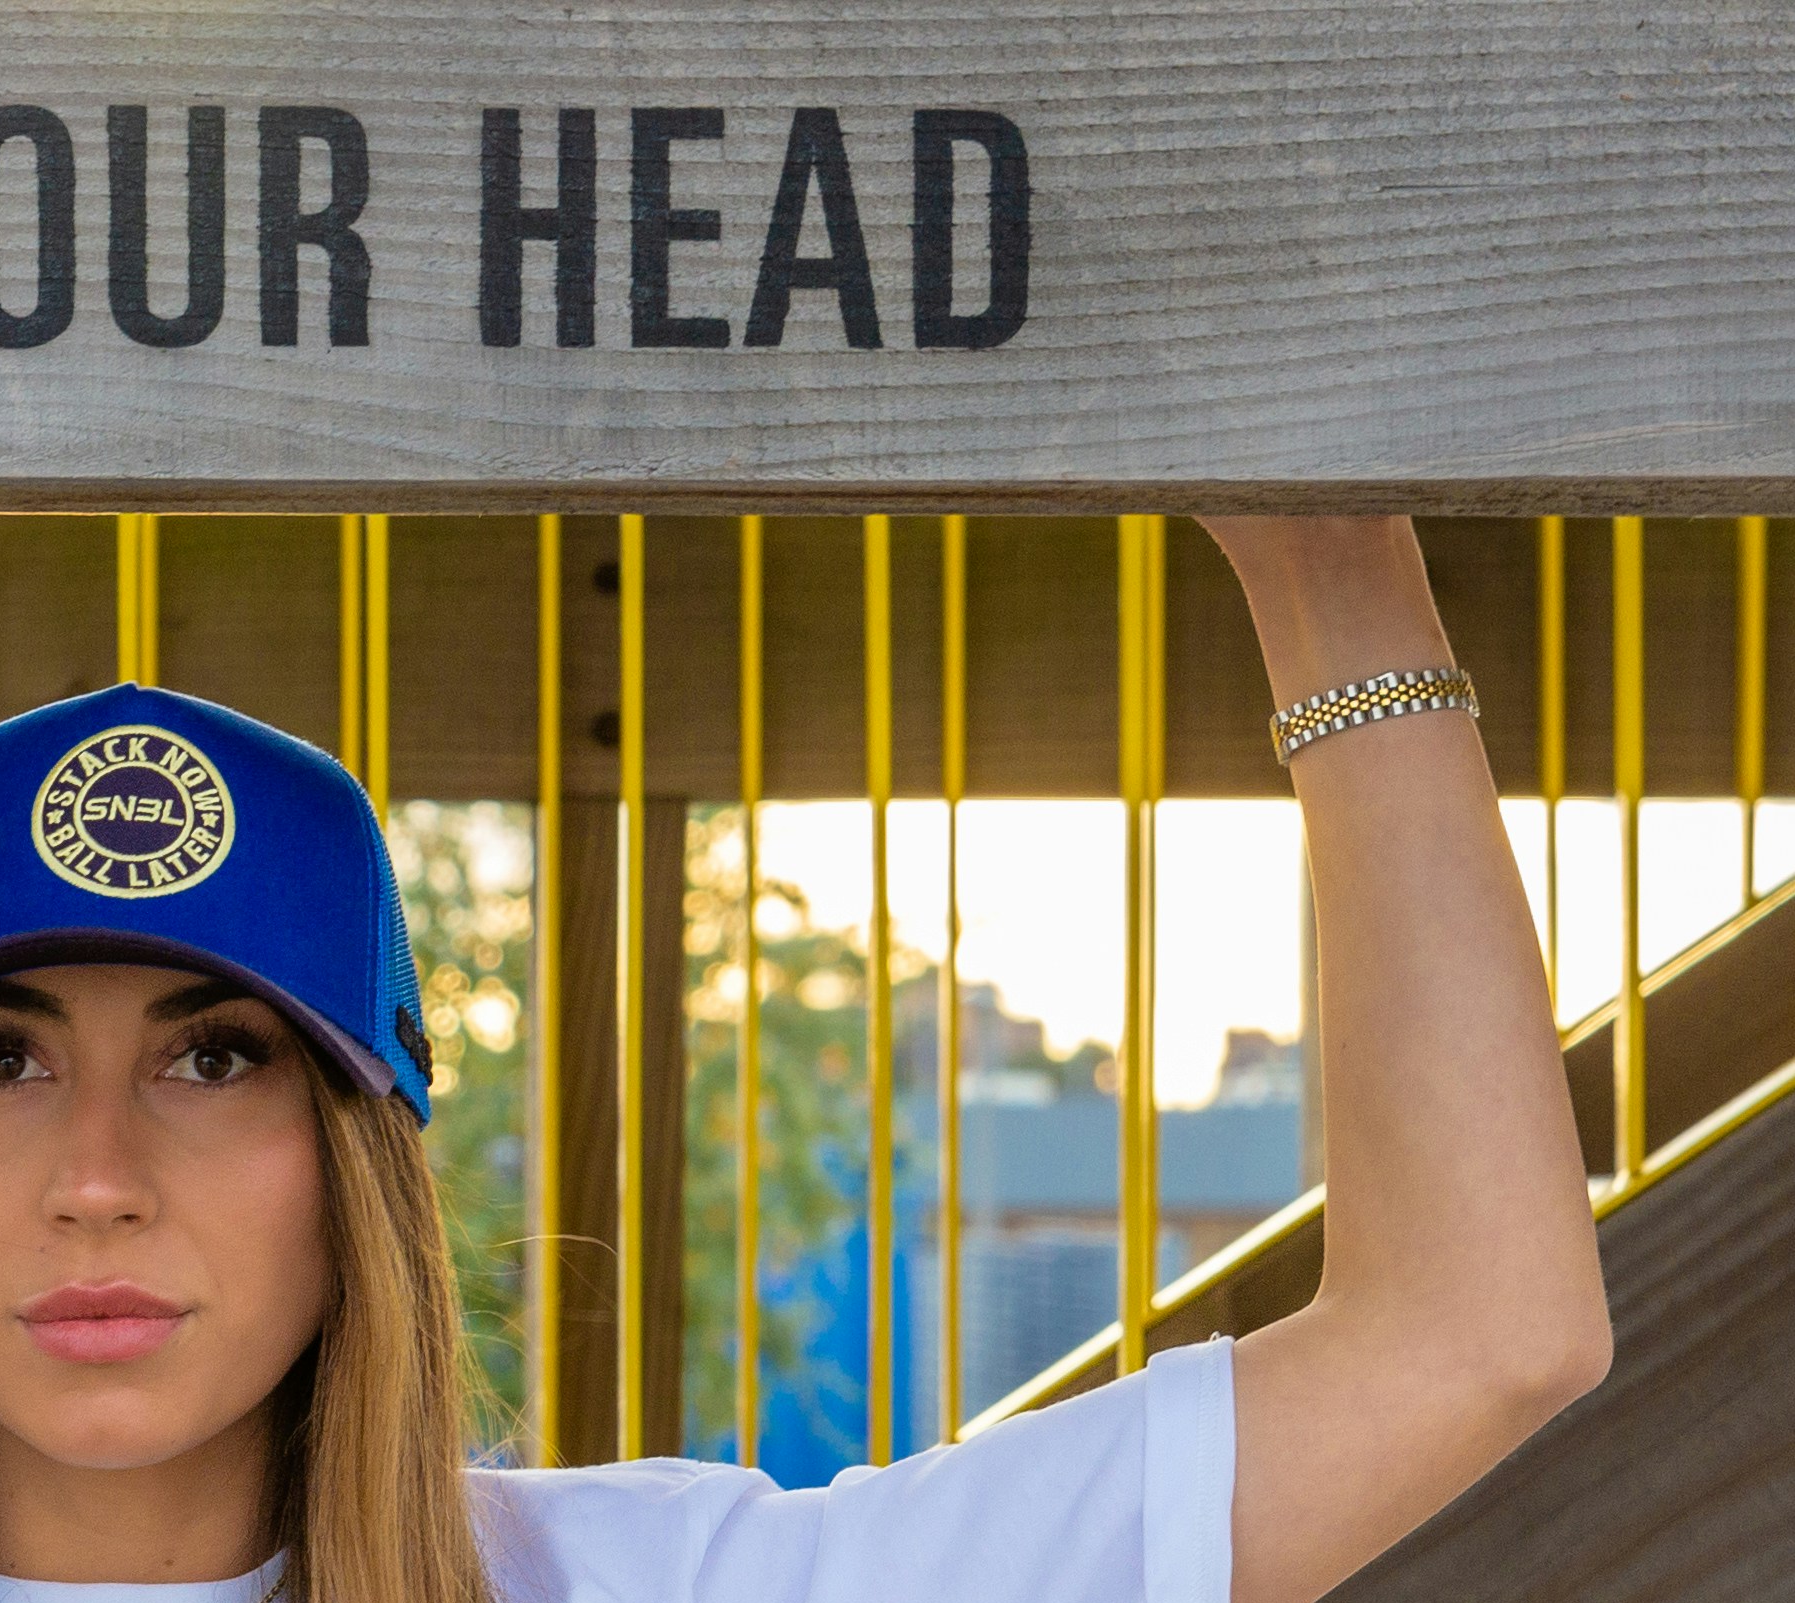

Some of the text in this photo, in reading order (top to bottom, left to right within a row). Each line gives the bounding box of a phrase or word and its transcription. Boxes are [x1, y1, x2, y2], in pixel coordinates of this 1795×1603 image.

[479, 106, 1032, 350] HEAD
[47, 737, 223, 812] STACK NOW
[46, 823, 221, 888] BALL LATER
